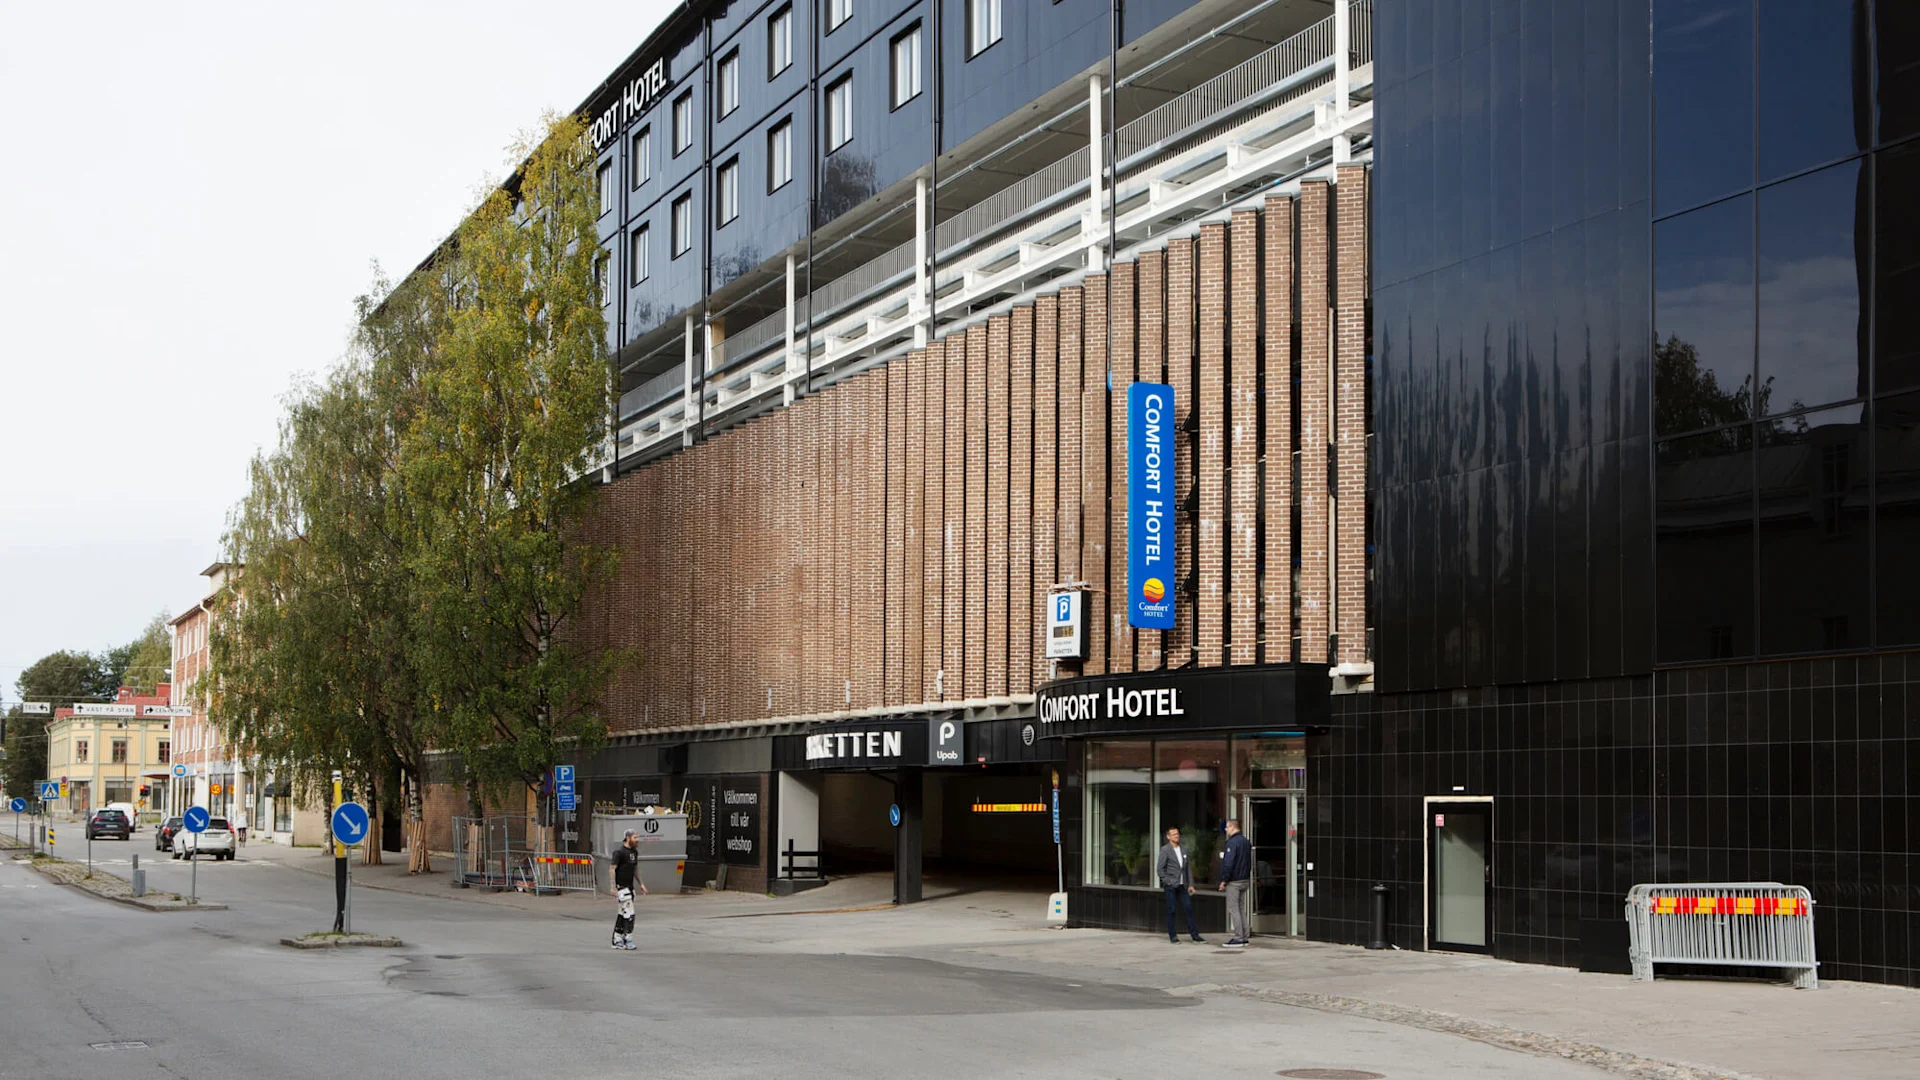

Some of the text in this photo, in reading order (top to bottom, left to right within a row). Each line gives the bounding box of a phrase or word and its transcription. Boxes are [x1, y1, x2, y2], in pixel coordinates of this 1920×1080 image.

[623, 57, 667, 123] HOTEL
[1145, 393, 1163, 566] COMFORT HOTEL
[1138, 601, 1169, 612] Comfort
[1039, 686, 1185, 724] COMFORT HOTEL
[936, 750, 959, 762] Upab
[723, 790, 758, 805] Välkommen
[730, 811, 750, 828] till vår
[726, 835, 753, 854] webshop
